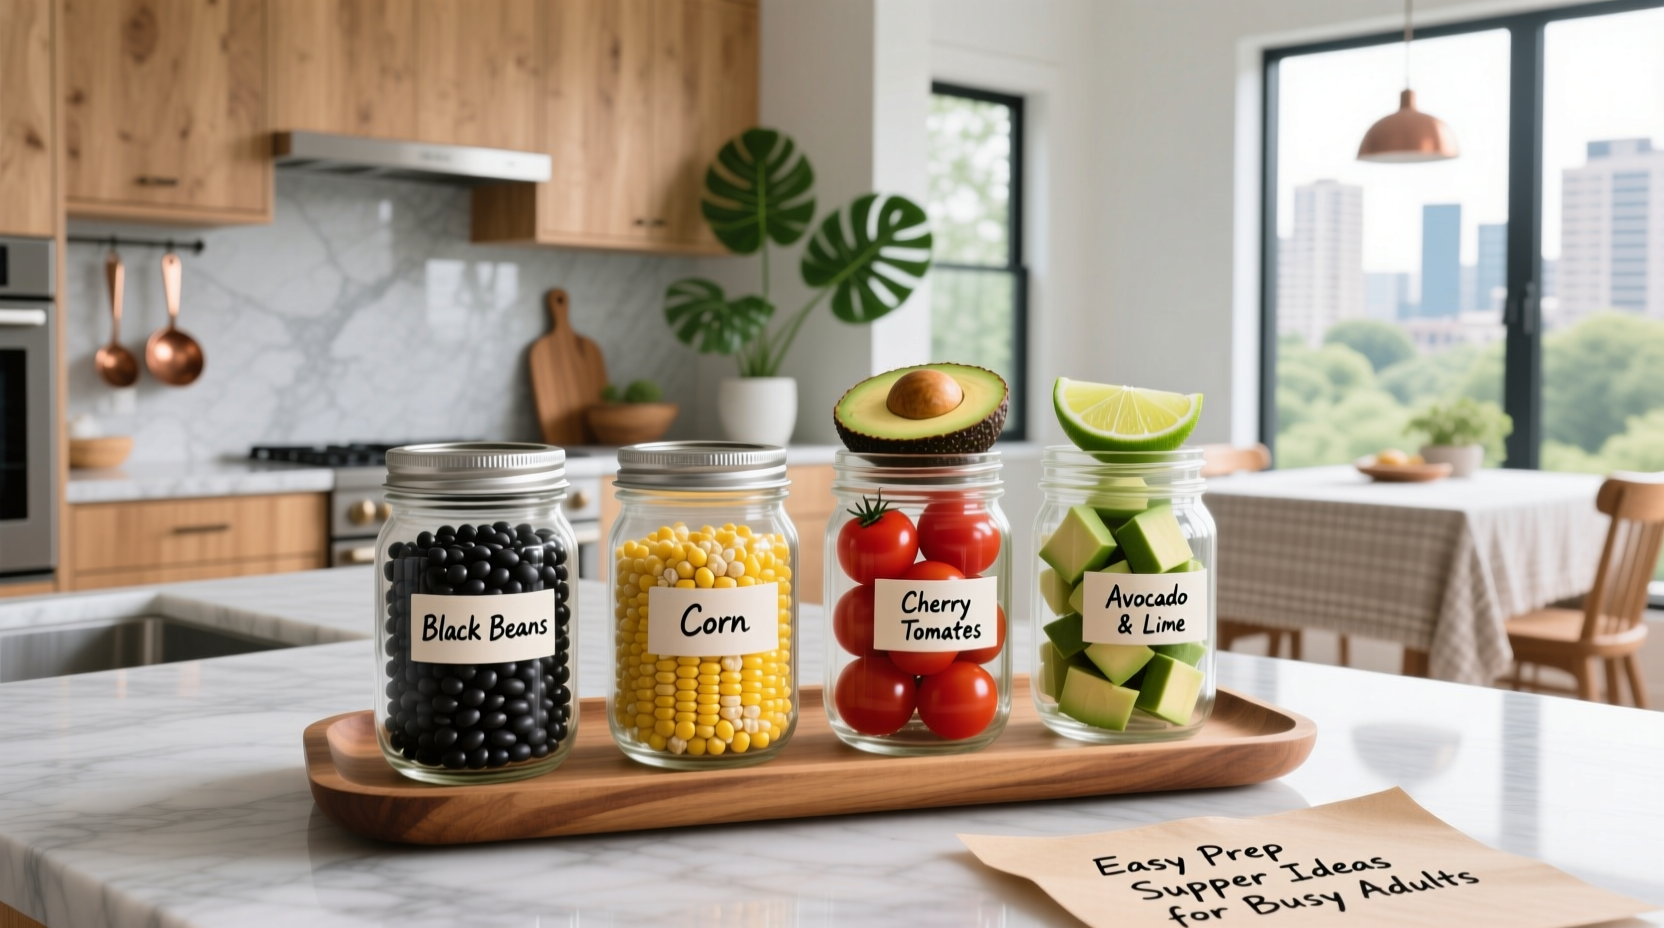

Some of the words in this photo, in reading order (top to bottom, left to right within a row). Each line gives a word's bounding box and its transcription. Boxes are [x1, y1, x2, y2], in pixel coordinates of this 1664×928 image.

[901, 590, 971, 621] Cherry
[1105, 583, 1189, 609] Avocado
[421, 613, 482, 642] Black
[489, 614, 549, 642] Beans
[679, 603, 751, 637] Corn
[900, 618, 982, 641] Tomates
[1117, 613, 1133, 635] &
[1142, 613, 1186, 635] Lime
[1092, 855, 1186, 876] Easy
[1196, 843, 1284, 867] Prep
[1130, 870, 1268, 903] Supper
[1279, 856, 1393, 883] Ideas
[1168, 904, 1229, 928] for
[1241, 891, 1347, 915] Busy
[1358, 869, 1481, 899] Adults
